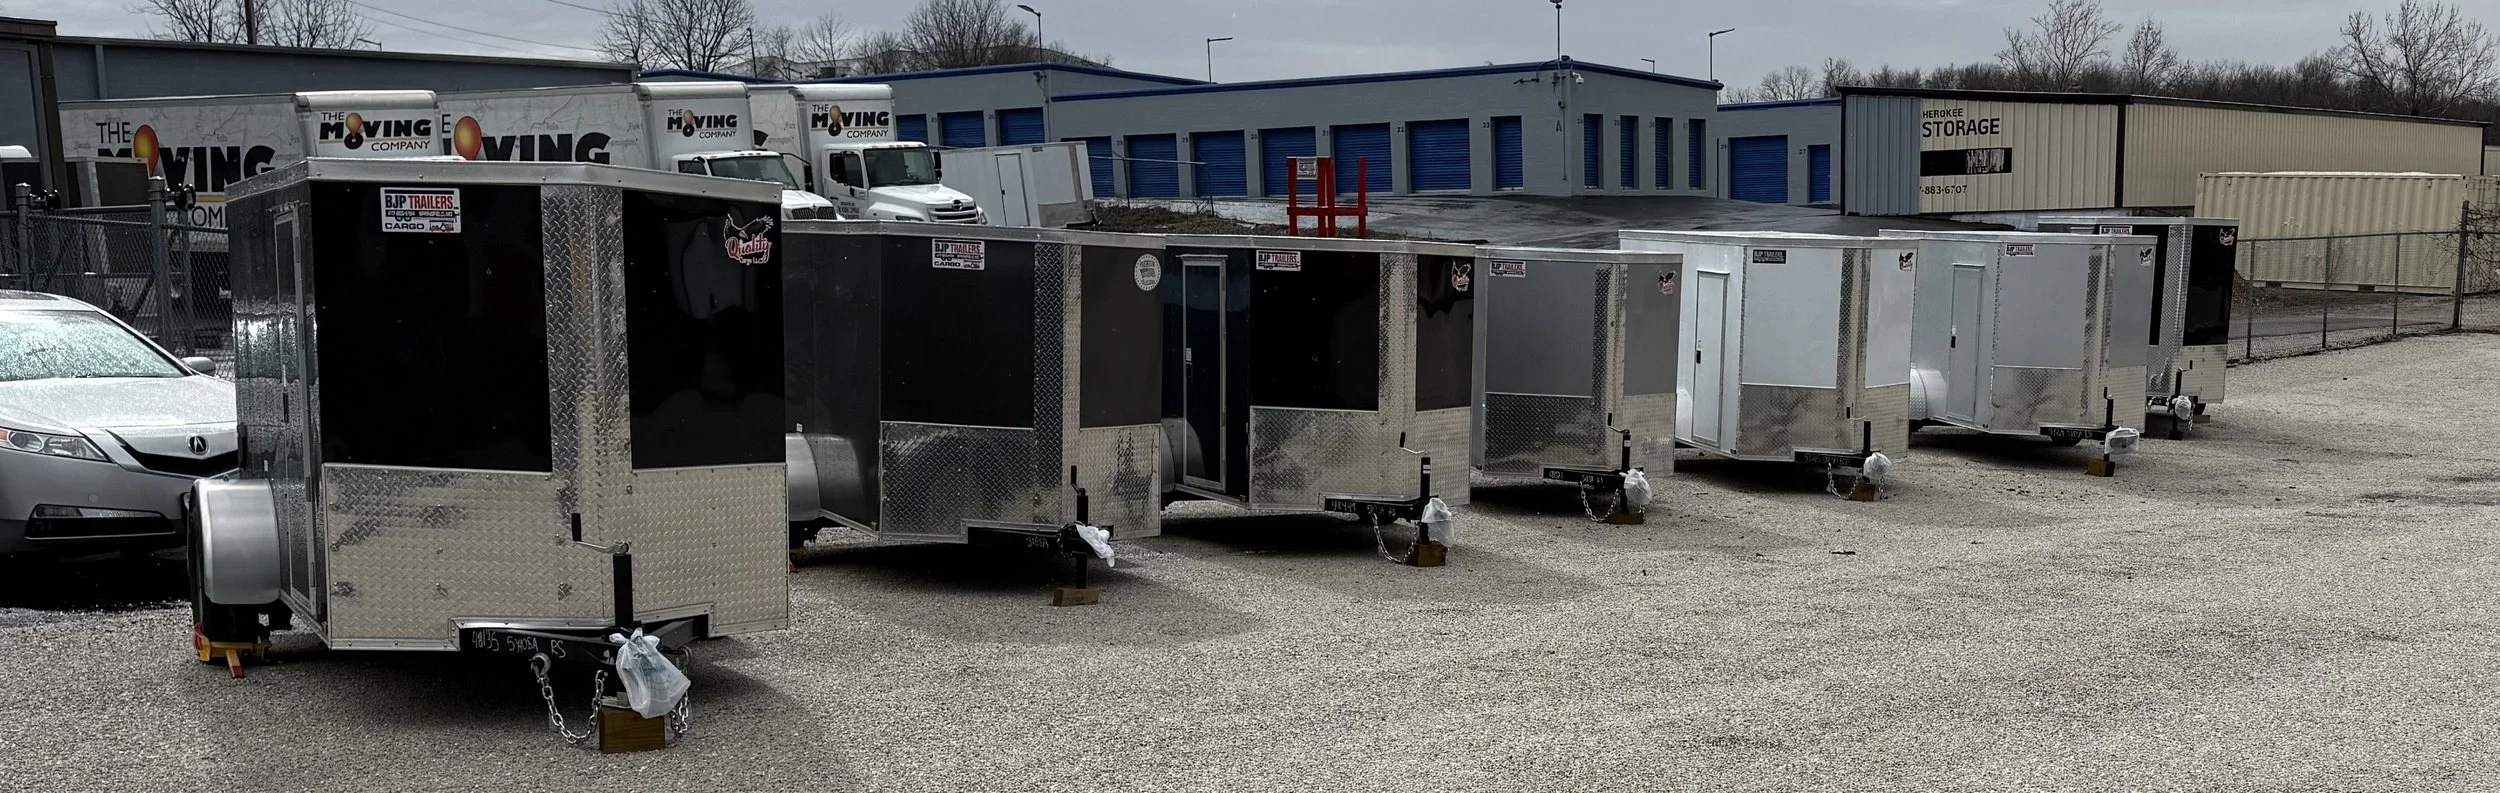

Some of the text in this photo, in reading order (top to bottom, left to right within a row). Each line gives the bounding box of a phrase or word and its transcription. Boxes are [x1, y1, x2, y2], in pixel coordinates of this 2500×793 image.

[812, 104, 828, 112] THE
[321, 112, 344, 120] THE
[667, 114, 737, 137] MOVING
[811, 111, 889, 136] MOVING
[1922, 118, 2000, 137] STORAGE
[96, 122, 131, 143] THE
[320, 118, 431, 149] MOVING
[699, 130, 736, 139] COMPANY
[847, 130, 888, 138] COMPANY
[371, 141, 430, 151] COMPANY
[385, 195, 453, 209] BJP TRAILERS
[935, 243, 980, 254] BJP TRAILERS
